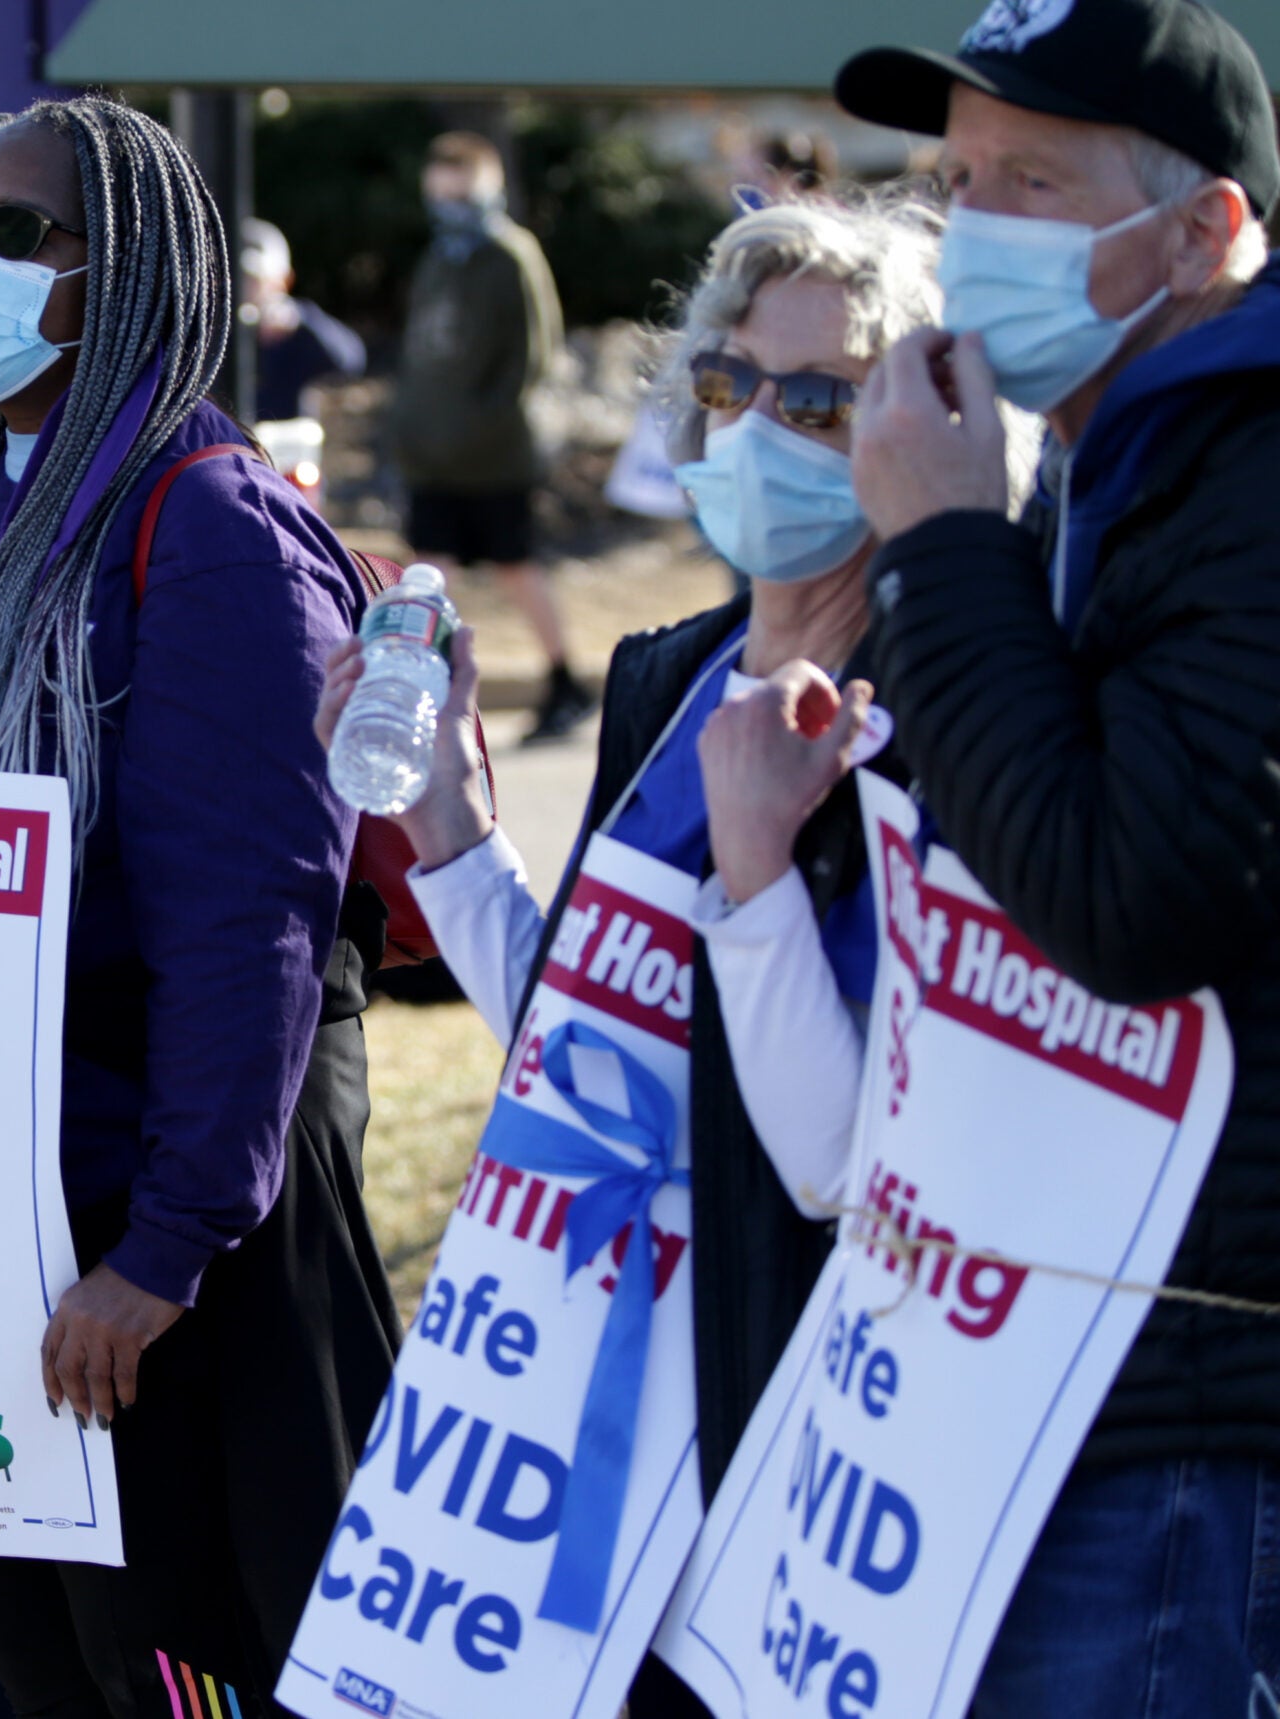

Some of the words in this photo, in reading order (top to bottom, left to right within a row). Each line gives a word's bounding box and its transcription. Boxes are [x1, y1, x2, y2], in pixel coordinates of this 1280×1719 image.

[357, 1371, 573, 1544] VID
[319, 1503, 523, 1674] Care
[762, 1551, 880, 1719] Care
